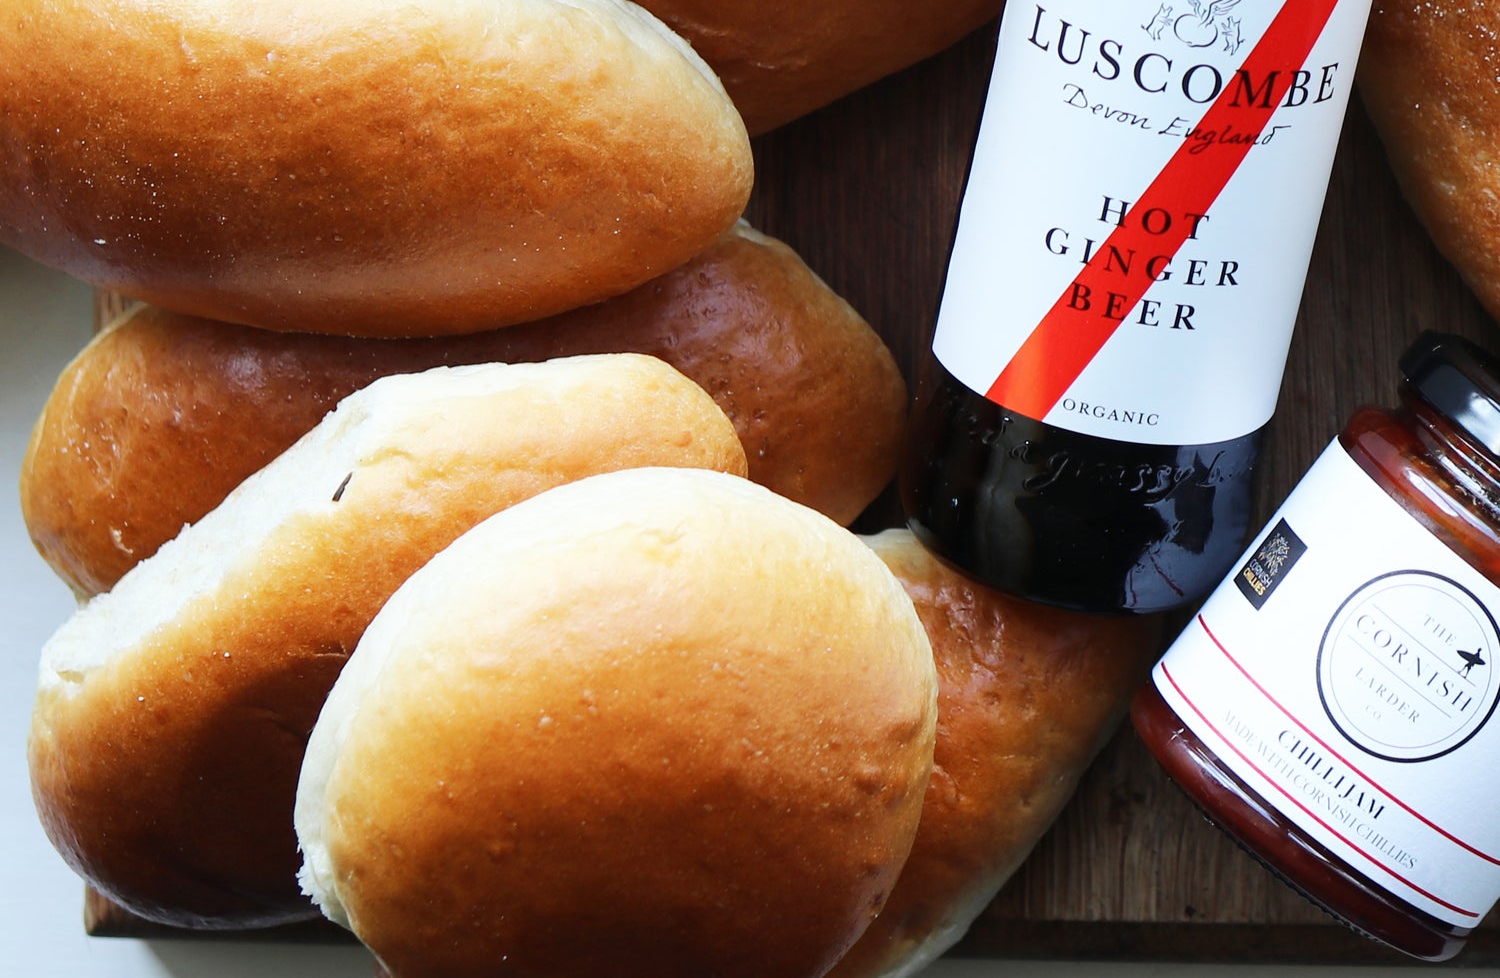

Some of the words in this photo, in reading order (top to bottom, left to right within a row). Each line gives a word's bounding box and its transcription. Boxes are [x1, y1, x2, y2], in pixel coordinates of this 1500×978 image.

[1027, 4, 1339, 108] LUSCOMBE
[1062, 83, 1151, 131] Devon
[1158, 116, 1292, 155] England
[1096, 195, 1209, 240] HOT
[1044, 227, 1240, 287] GINGER
[1067, 282, 1196, 330] BEER
[1062, 397, 1160, 426] ORGANIC
[1424, 614, 1457, 647] THE
[1356, 614, 1472, 711] CORNISH
[1355, 667, 1420, 723] LARDER
[1224, 710, 1258, 745] MADE
[1257, 740, 1295, 779] WITH
[1293, 773, 1358, 829] CORNISH
[1356, 823, 1418, 871] CHILLIES
[1278, 730, 1345, 790] CHILLI
[1337, 783, 1385, 820] JAM
